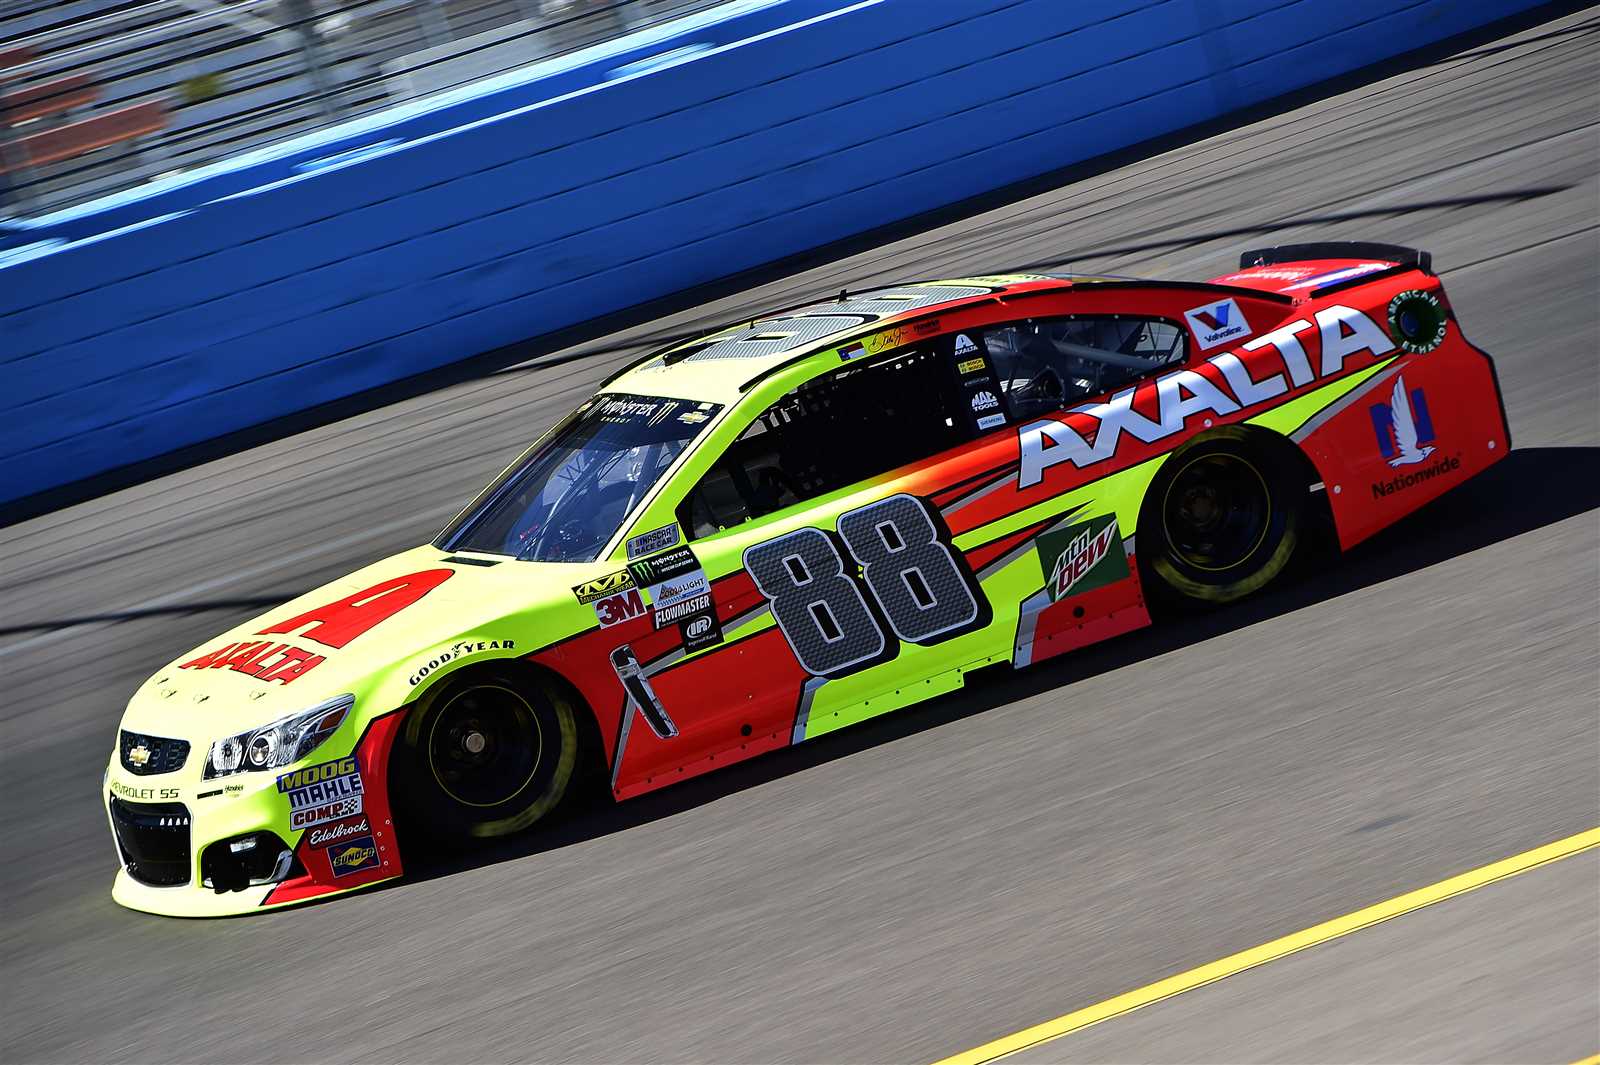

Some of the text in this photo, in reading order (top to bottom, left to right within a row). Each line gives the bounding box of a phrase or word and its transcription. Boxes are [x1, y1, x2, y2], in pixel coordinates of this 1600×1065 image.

[1388, 290, 1439, 324] AMERICAN
[1204, 325, 1242, 342] Valvoline
[1402, 320, 1447, 354] ETHANOL
[955, 345, 978, 356] AXALTA
[600, 399, 658, 417] MONSTER
[971, 391, 998, 407] MAC
[973, 401, 999, 411] TOOLS
[1017, 304, 1397, 492] AXALTA
[1371, 457, 1461, 499] Nationwide
[634, 537, 673, 556] RACE CAR
[640, 527, 672, 546] NASCAR
[651, 550, 690, 566] MONSTER
[579, 580, 635, 604] MECHANIX WEAR
[683, 578, 705, 591] LIGHT
[741, 492, 979, 676] 88
[596, 588, 646, 625] 3M
[655, 595, 710, 630] FLOWMASTER
[177, 641, 328, 686] AXALTA
[281, 758, 355, 791] MOOG
[159, 788, 180, 799] SS
[288, 774, 362, 809] MAHLE
[293, 802, 344, 826] COMP
[310, 819, 369, 845] Edelbrock
[333, 847, 375, 867] SUNOCO
